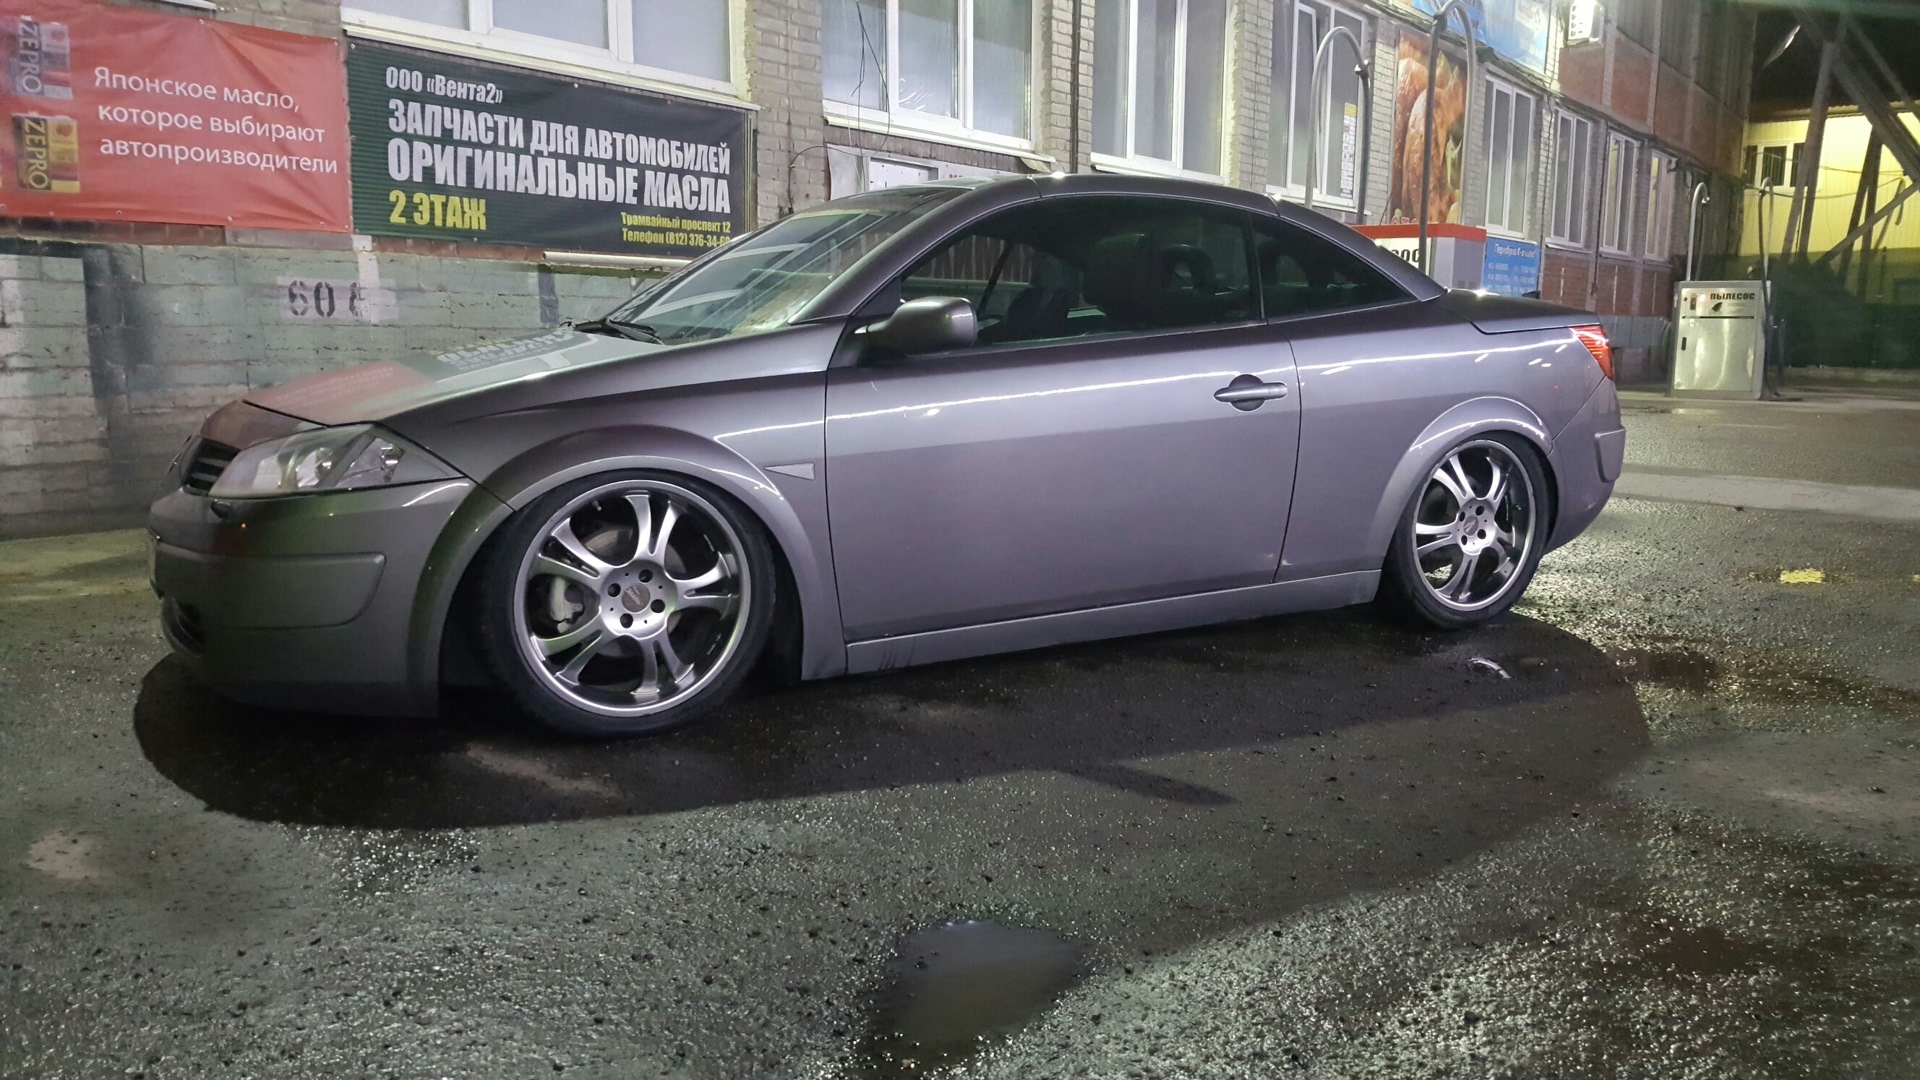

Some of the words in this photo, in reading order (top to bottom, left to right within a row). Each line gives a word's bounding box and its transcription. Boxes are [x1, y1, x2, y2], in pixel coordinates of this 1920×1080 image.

[20, 21, 41, 93] ZEPRO
[94, 66, 217, 100] Японское
[223, 87, 299, 112] масло,
[386, 66, 423, 93] ООО
[427, 74, 503, 104] «Вента2»
[98, 105, 203, 131] которое
[210, 115, 325, 142] выбирают
[388, 98, 524, 148] ЗАПЧАСТИ
[530, 119, 579, 156] ДЛЯ
[584, 127, 731, 175] АВТОМОБИЛЕЙ
[24, 118, 49, 189] ZEPRO
[100, 139, 338, 173] автопроизводители
[387, 137, 638, 205] ОРИГИНАЛЬНЫЕ
[643, 170, 731, 214] МАСЛА
[389, 190, 407, 224] 2
[413, 192, 487, 230] ЭТАЖ
[621, 212, 680, 229] Трамвайный
[681, 220, 721, 232] проспект
[722, 221, 731, 233] 12
[622, 228, 664, 244] Телефон
[666, 232, 687, 246] (812)
[1710, 292, 1756, 300] ПЫЛЕСОС
